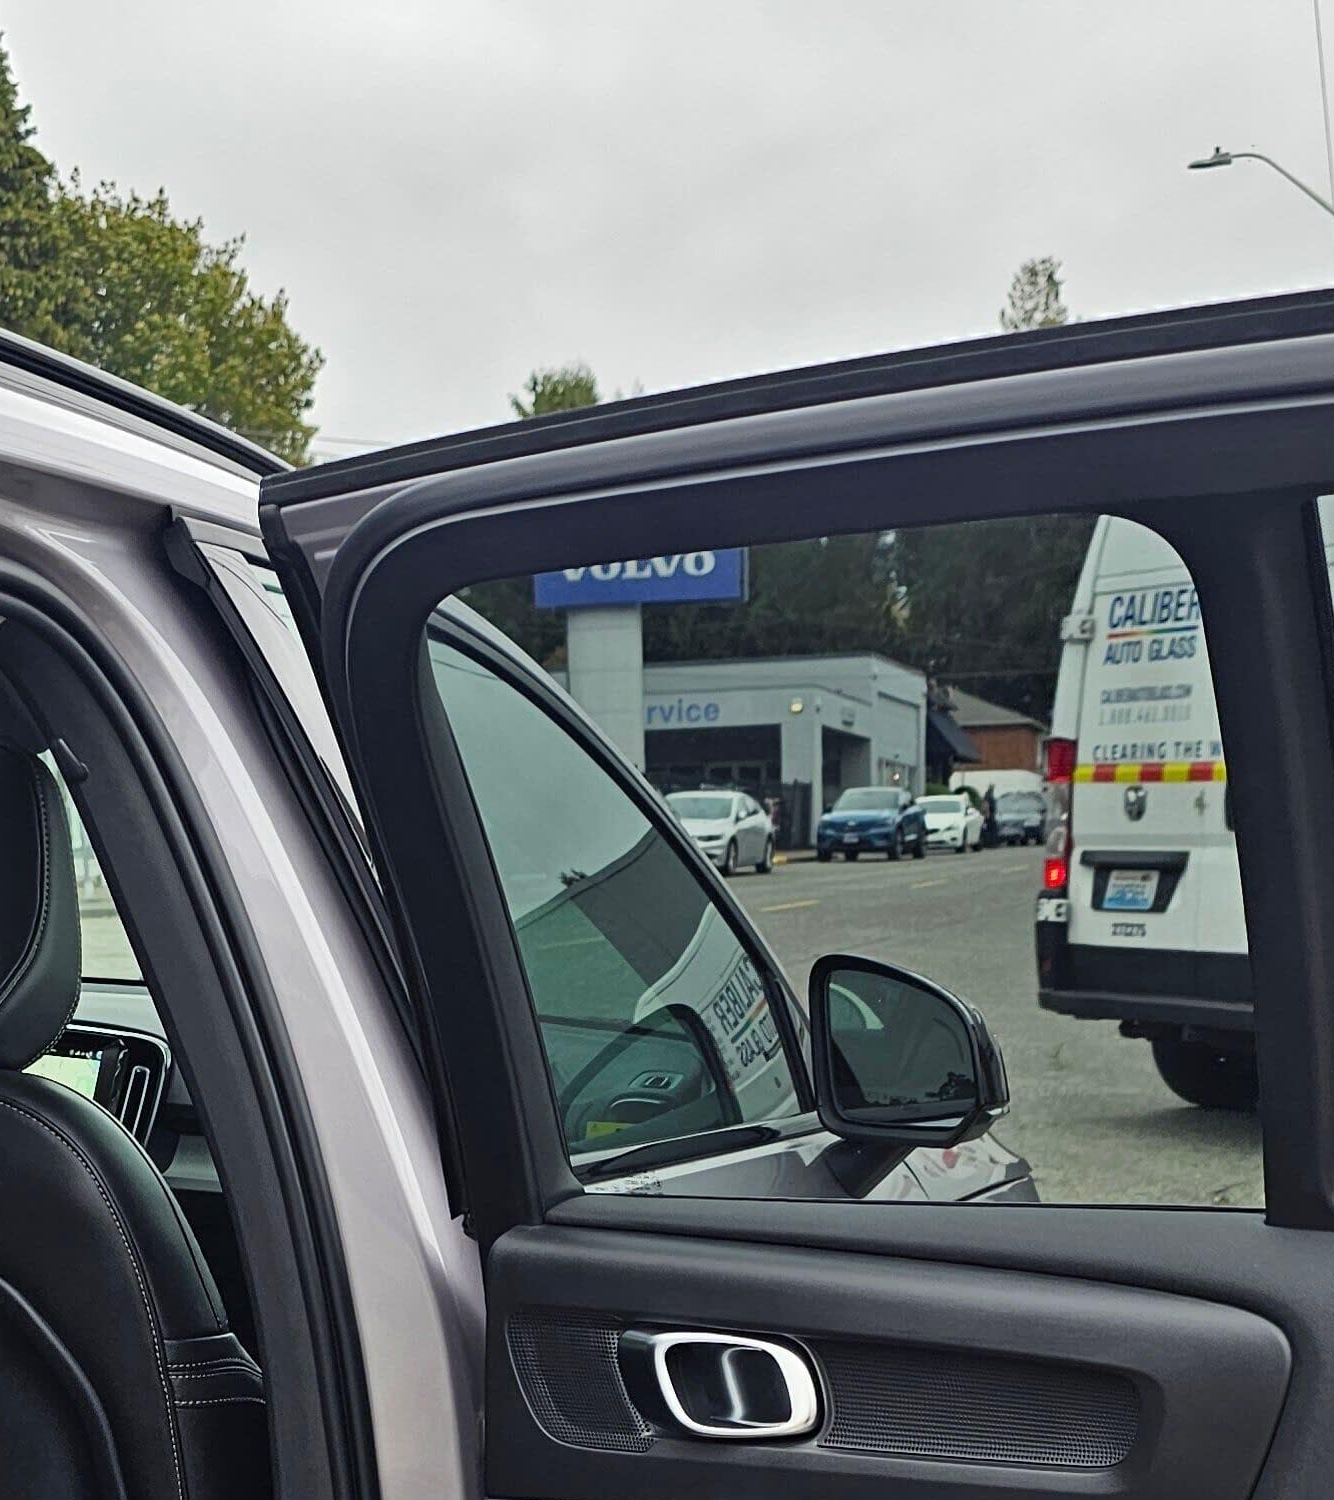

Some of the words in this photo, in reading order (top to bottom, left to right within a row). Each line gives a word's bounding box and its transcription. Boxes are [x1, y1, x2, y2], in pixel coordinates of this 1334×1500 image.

[1103, 639, 1143, 665] AUTO
[1147, 635, 1198, 662] GLASS
[646, 698, 721, 725] rvice
[1093, 741, 1167, 761] CLEARING
[1173, 740, 1203, 759] THE
